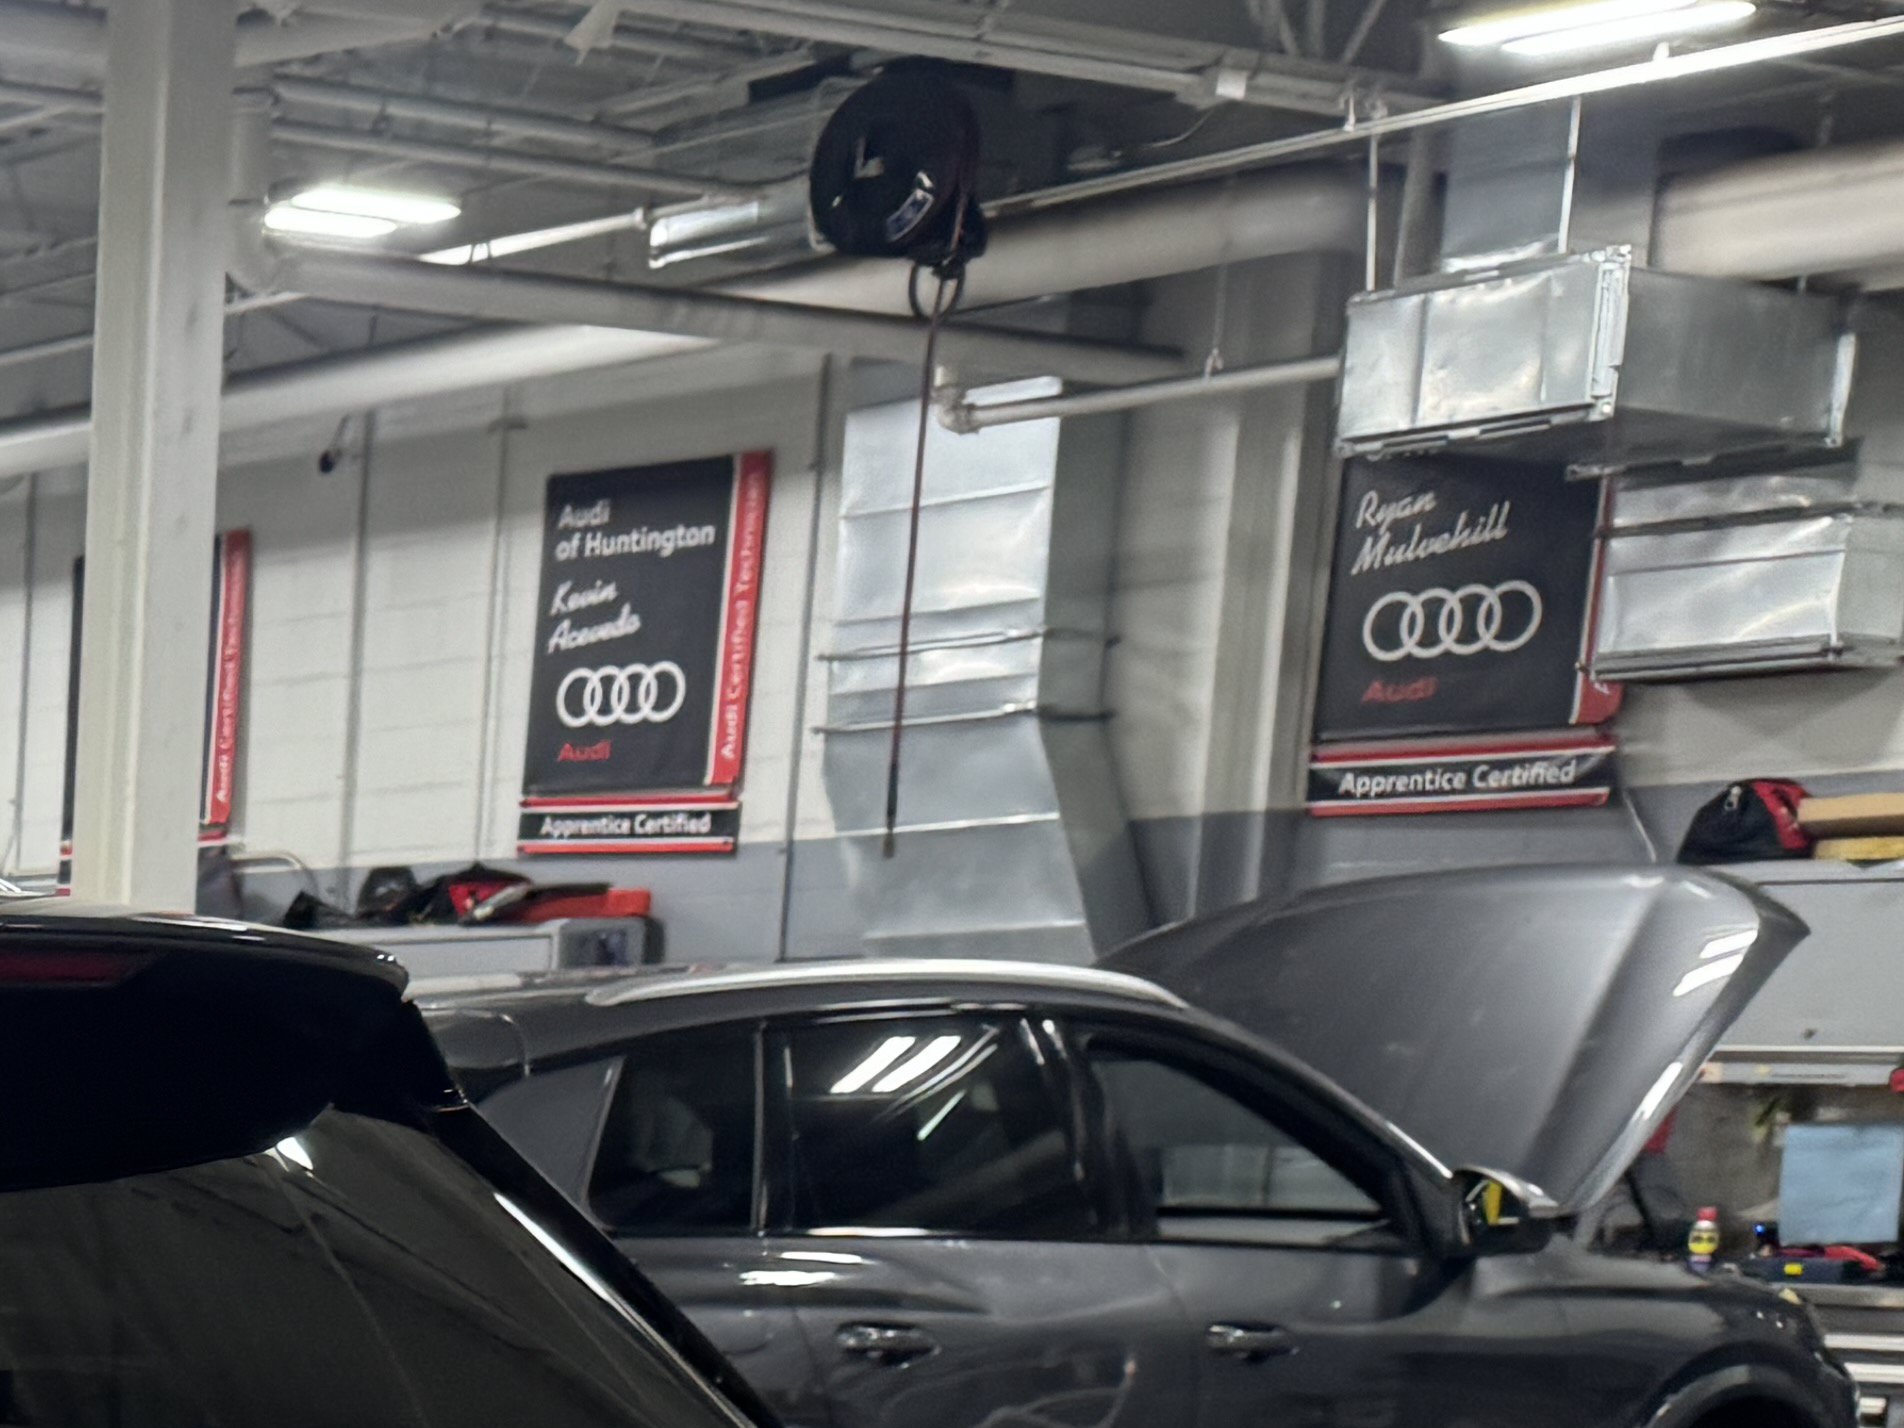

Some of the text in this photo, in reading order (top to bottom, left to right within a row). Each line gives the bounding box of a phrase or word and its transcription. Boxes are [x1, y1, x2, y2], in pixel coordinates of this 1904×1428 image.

[558, 499, 611, 529] Audi
[1356, 490, 1437, 535] Ryan
[555, 524, 717, 561] of Huntington
[1361, 677, 1439, 703] Audi
[721, 704, 738, 760] Audi
[557, 740, 611, 762] Audi
[1338, 760, 1577, 797] Apprentice Certified
[540, 811, 712, 839] Apprentice Certified
